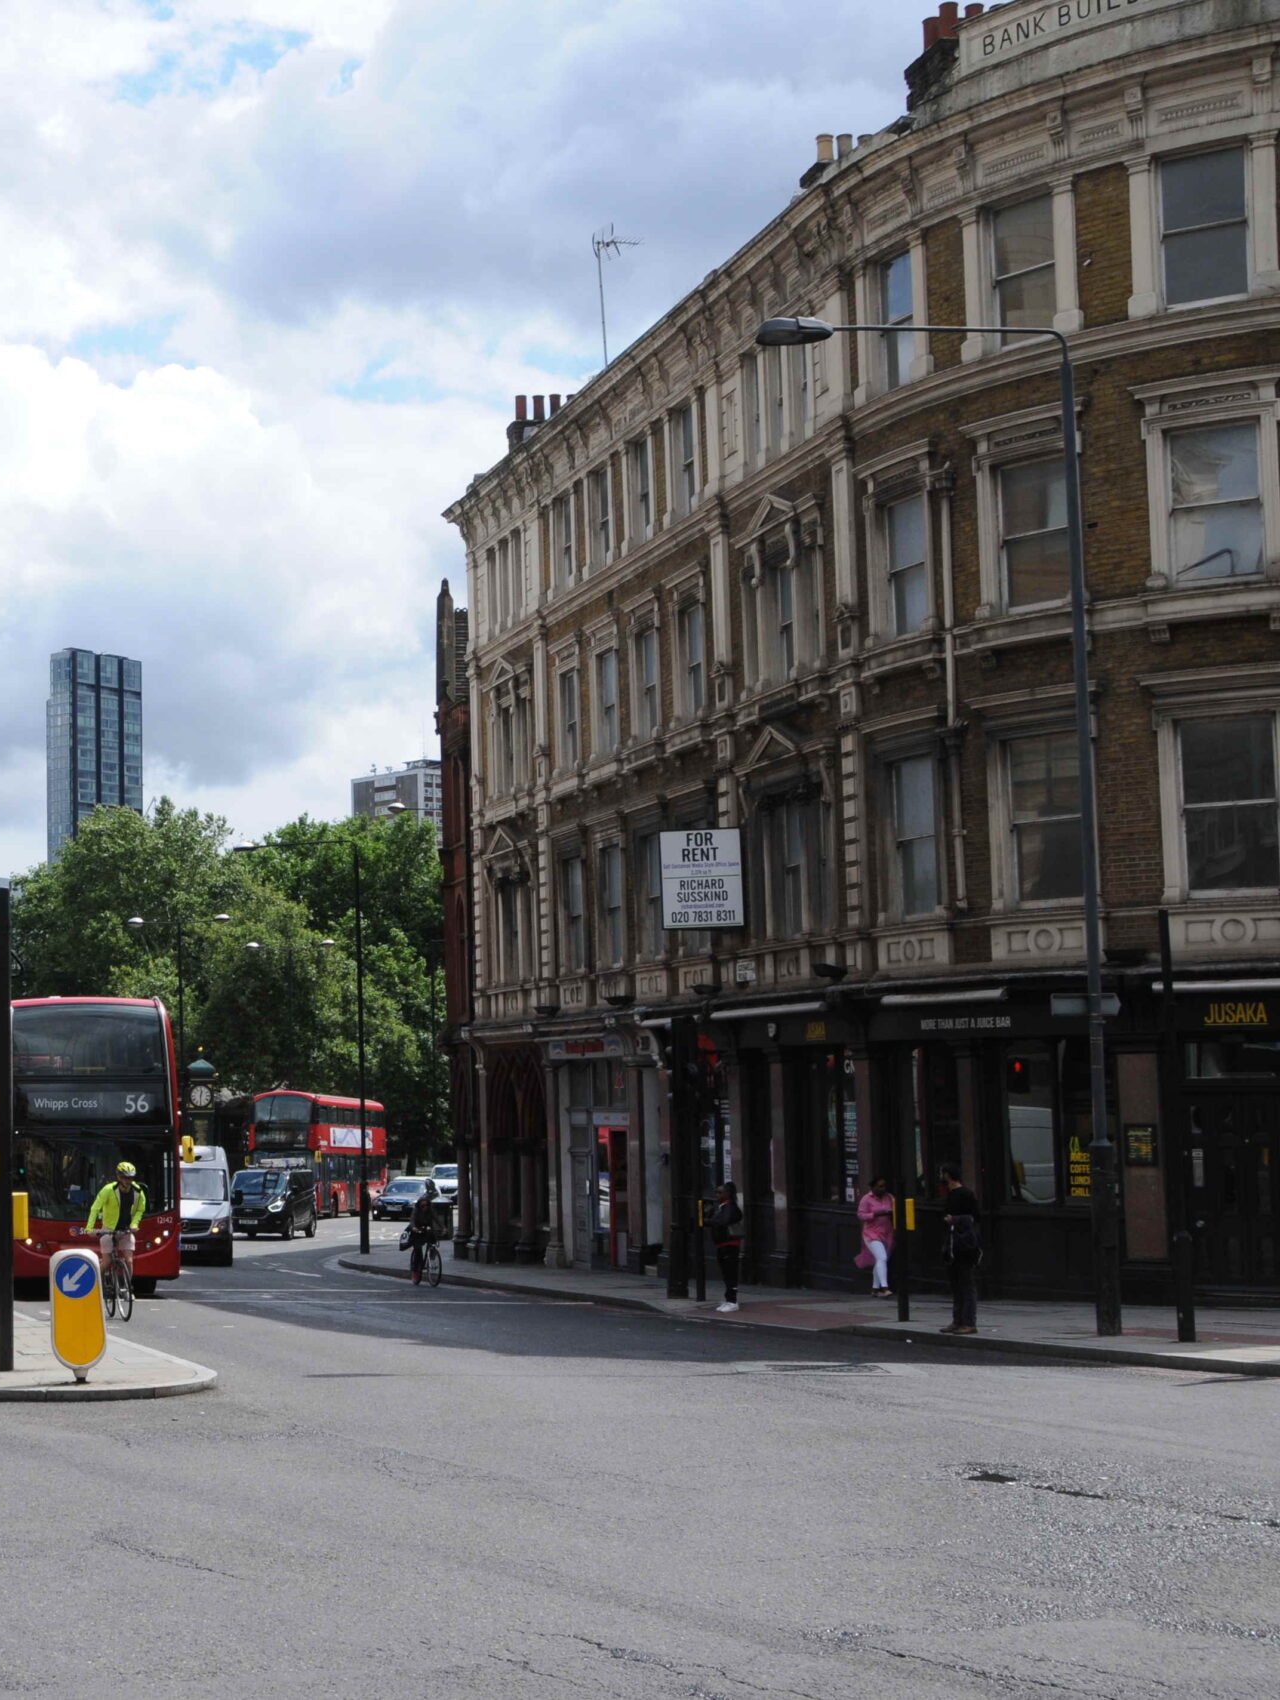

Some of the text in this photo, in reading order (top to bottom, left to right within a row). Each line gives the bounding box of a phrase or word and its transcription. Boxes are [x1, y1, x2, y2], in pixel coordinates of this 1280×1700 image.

[982, 0, 1140, 56] BANK BUIL
[686, 832, 713, 847] FOR
[681, 847, 719, 862] RENT
[680, 879, 724, 890] RICHARD
[677, 890, 729, 903] SUSSKIND
[671, 910, 736, 923] 020 7831 8311
[1204, 1001, 1268, 1024] JUSAKA
[920, 1016, 1011, 1030] MORE THAN JUST A JUICE BAR
[33, 1094, 149, 1113] Whipps Cross 56
[1070, 1164, 1091, 1174] COFFE
